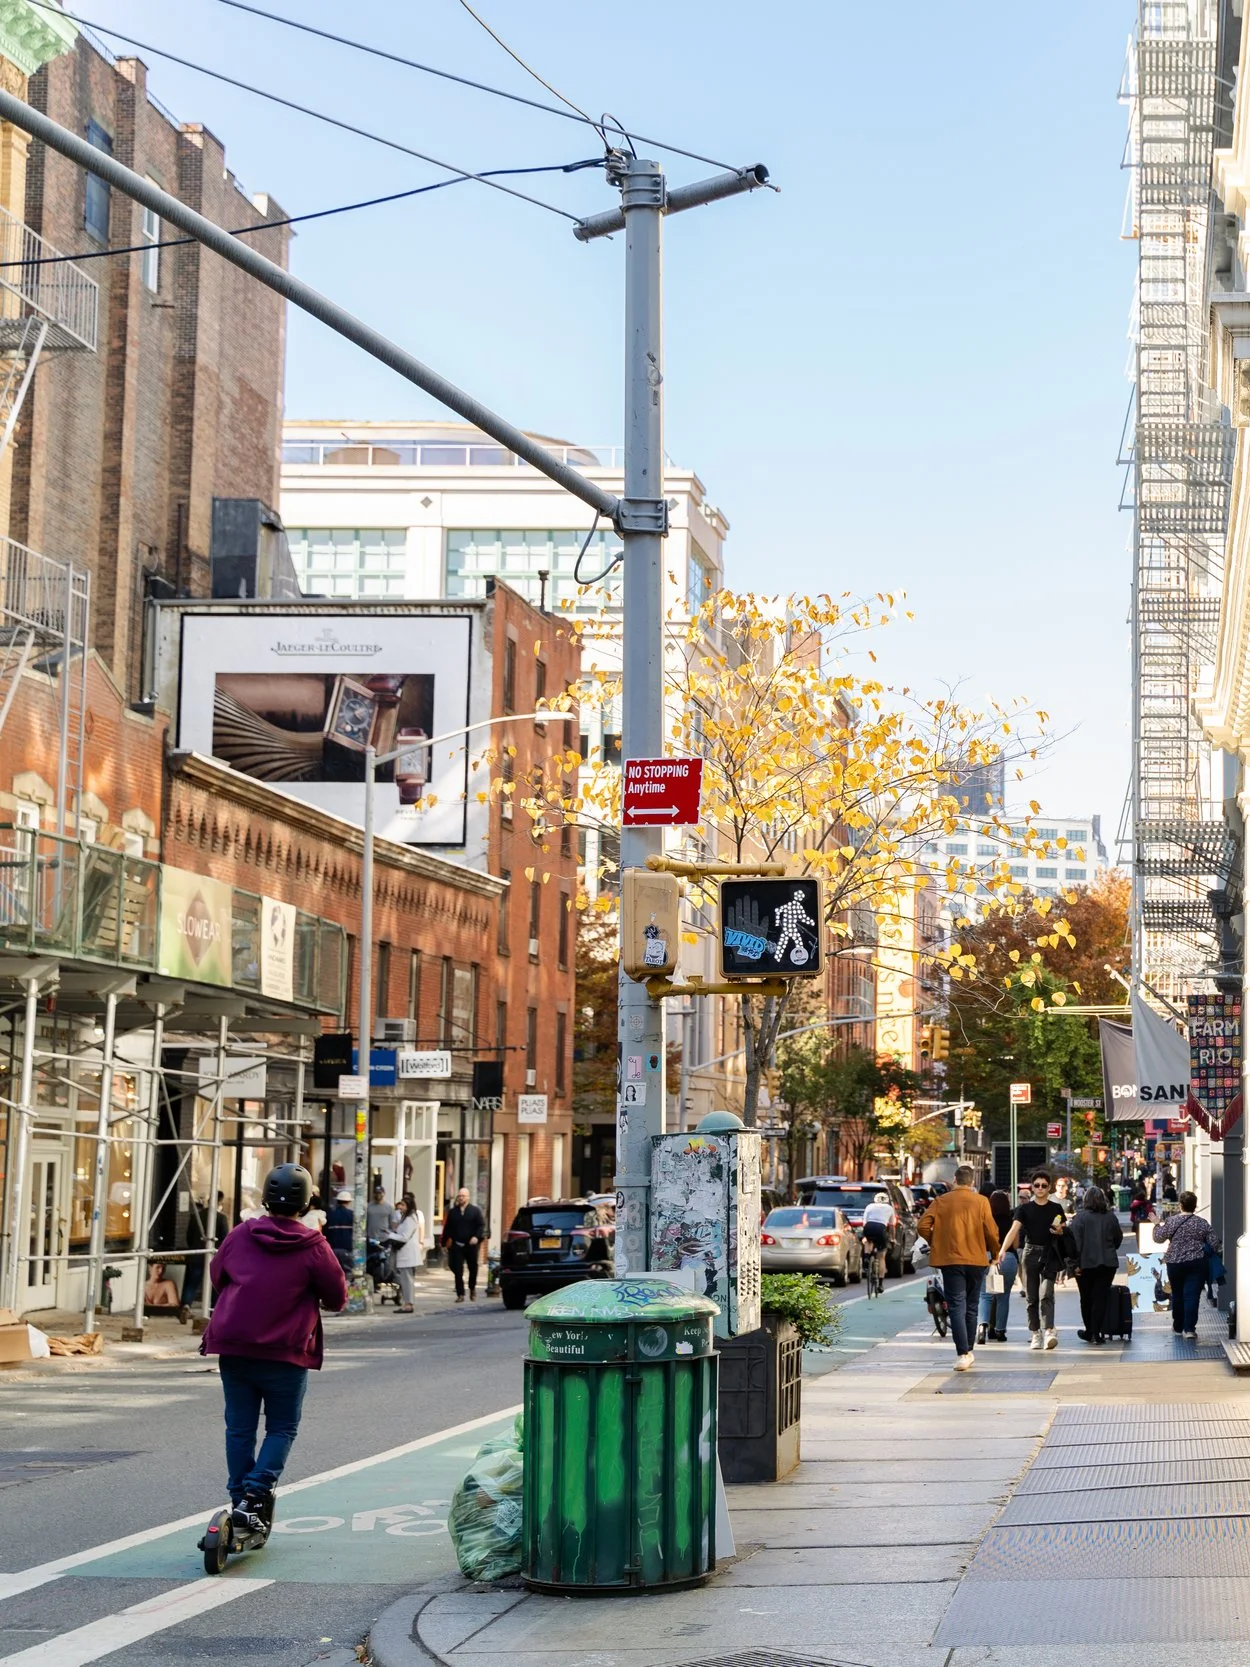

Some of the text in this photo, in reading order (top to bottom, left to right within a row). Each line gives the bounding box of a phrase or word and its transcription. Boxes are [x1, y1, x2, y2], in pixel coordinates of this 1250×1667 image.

[628, 765, 689, 778] NO STOPPING
[628, 781, 666, 796] Anytime
[177, 913, 221, 942] SLOWEAR
[1191, 1020, 1239, 1036] FARM
[1200, 1048, 1232, 1065] RIO
[409, 1060, 441, 1070] Wolford
[1140, 1084, 1189, 1101] SAN
[472, 1096, 504, 1110] NARS
[546, 1344, 585, 1355] Beautiful
